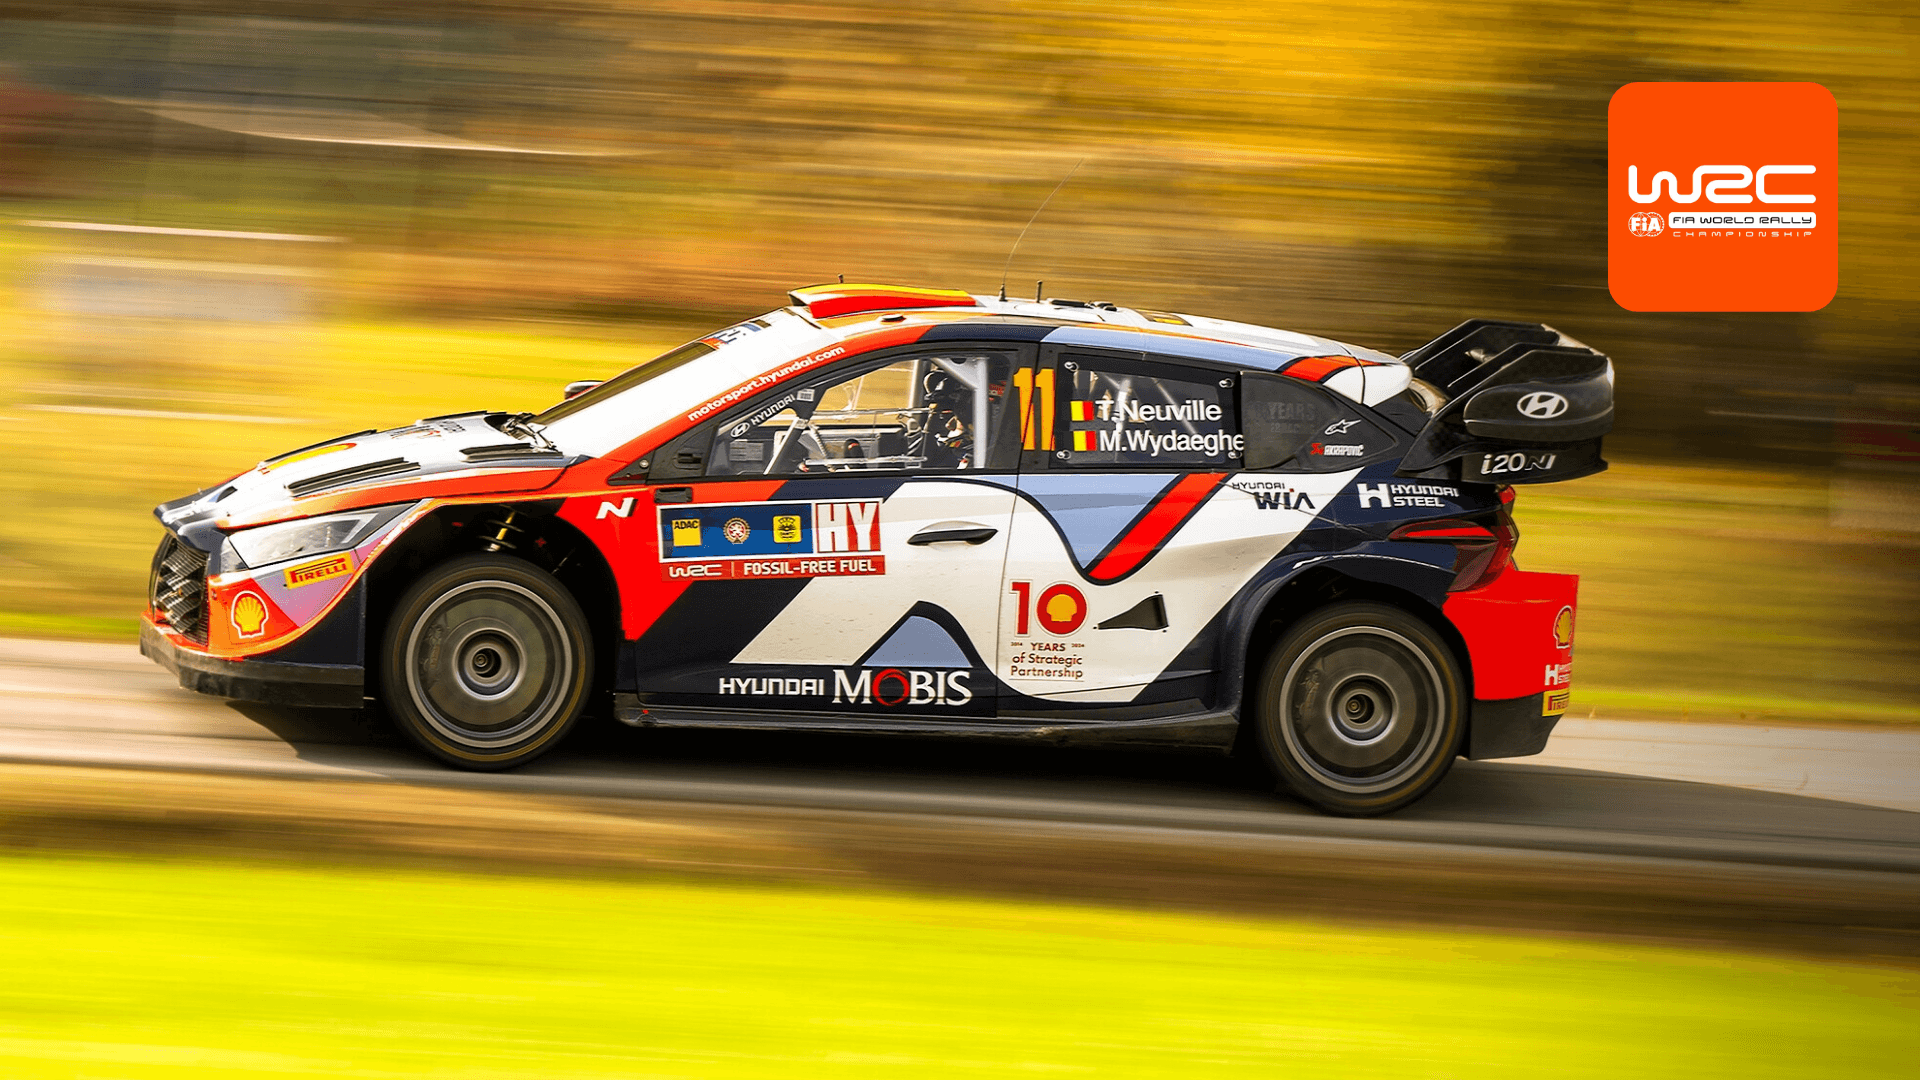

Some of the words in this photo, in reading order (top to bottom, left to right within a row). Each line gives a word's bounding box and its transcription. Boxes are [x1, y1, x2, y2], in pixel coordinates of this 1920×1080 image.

[688, 346, 845, 422] motorsport.hyundai.com
[750, 394, 796, 426] HYUNDAI
[1012, 367, 1056, 451] 11
[1099, 429, 1244, 457] M.Wydaeghe
[1232, 482, 1286, 490] HYUNDAI
[1391, 484, 1460, 498] HYUNDAI
[1393, 496, 1446, 508] STEEL
[674, 520, 699, 530] ADAC
[816, 502, 879, 552] HY
[290, 558, 348, 583] PIRELLI
[669, 564, 723, 578] WRC
[743, 560, 837, 576] FOSSIL-FREE
[840, 559, 876, 572] FUEL
[1030, 642, 1066, 652] YEARS
[1012, 651, 1026, 664] of
[1028, 653, 1083, 668] Strategic
[1010, 665, 1083, 680] Partnership
[719, 678, 824, 696] HYUNDAI
[832, 668, 973, 706] MOBIS
